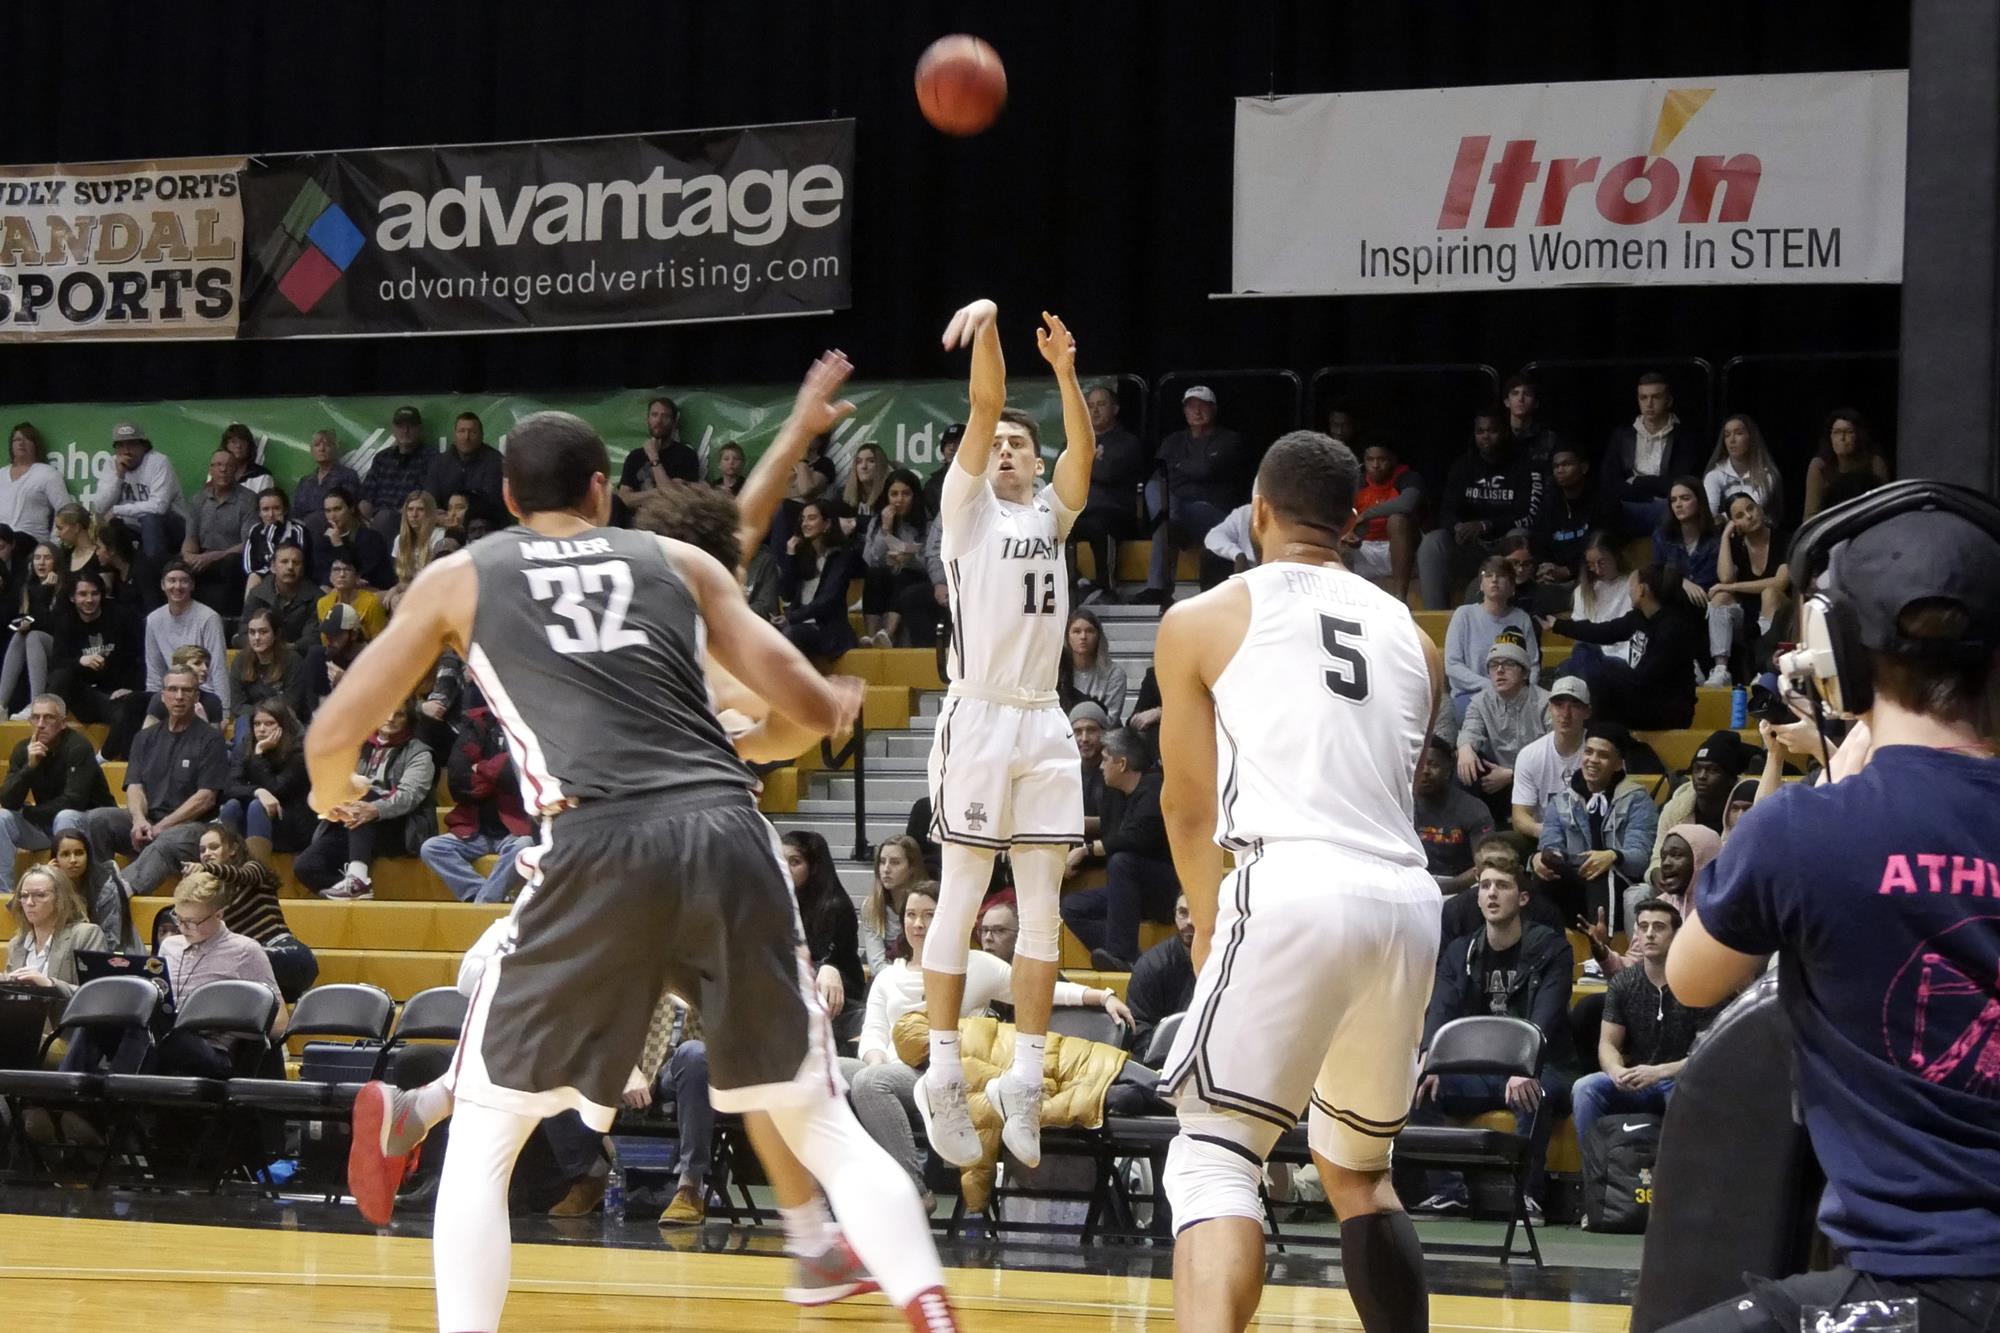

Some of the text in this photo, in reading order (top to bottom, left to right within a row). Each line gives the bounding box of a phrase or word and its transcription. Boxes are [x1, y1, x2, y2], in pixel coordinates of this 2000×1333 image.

[74, 173, 237, 205] SUPPORTS
[376, 164, 844, 252] advantage
[1436, 135, 1762, 230] Itron
[0, 208, 235, 266] ANDAL
[1360, 228, 1842, 284] Inspiring Women In STEM
[379, 255, 840, 304] advantageadvertising.com
[1465, 487, 1514, 501] HOLLISTER
[519, 538, 614, 560] MILLER
[520, 560, 649, 653] 32
[1023, 571, 1056, 616] 12
[1281, 570, 1381, 611] FORRE
[1315, 609, 1372, 705] 5
